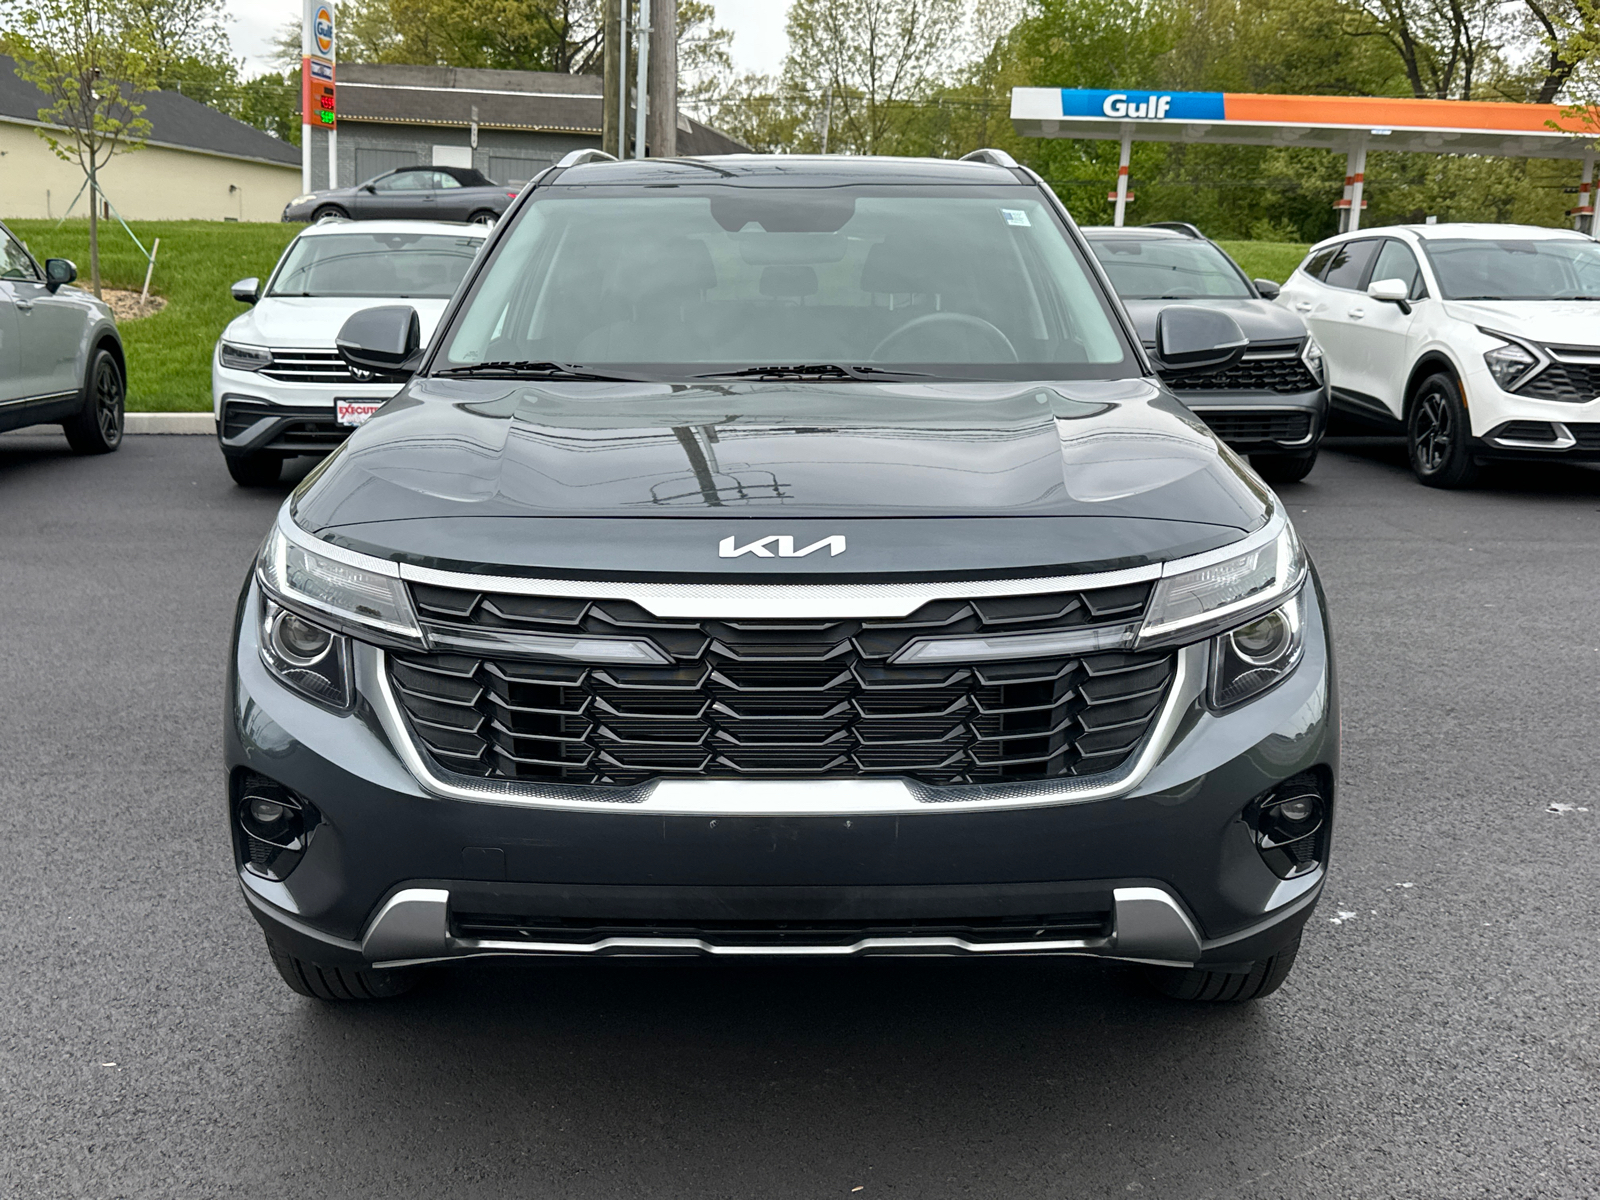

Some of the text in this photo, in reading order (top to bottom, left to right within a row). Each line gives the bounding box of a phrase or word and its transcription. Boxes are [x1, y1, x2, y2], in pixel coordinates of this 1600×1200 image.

[317, 21, 333, 39] Gulf
[1102, 93, 1172, 119] Gulf
[718, 534, 847, 558] KIA
